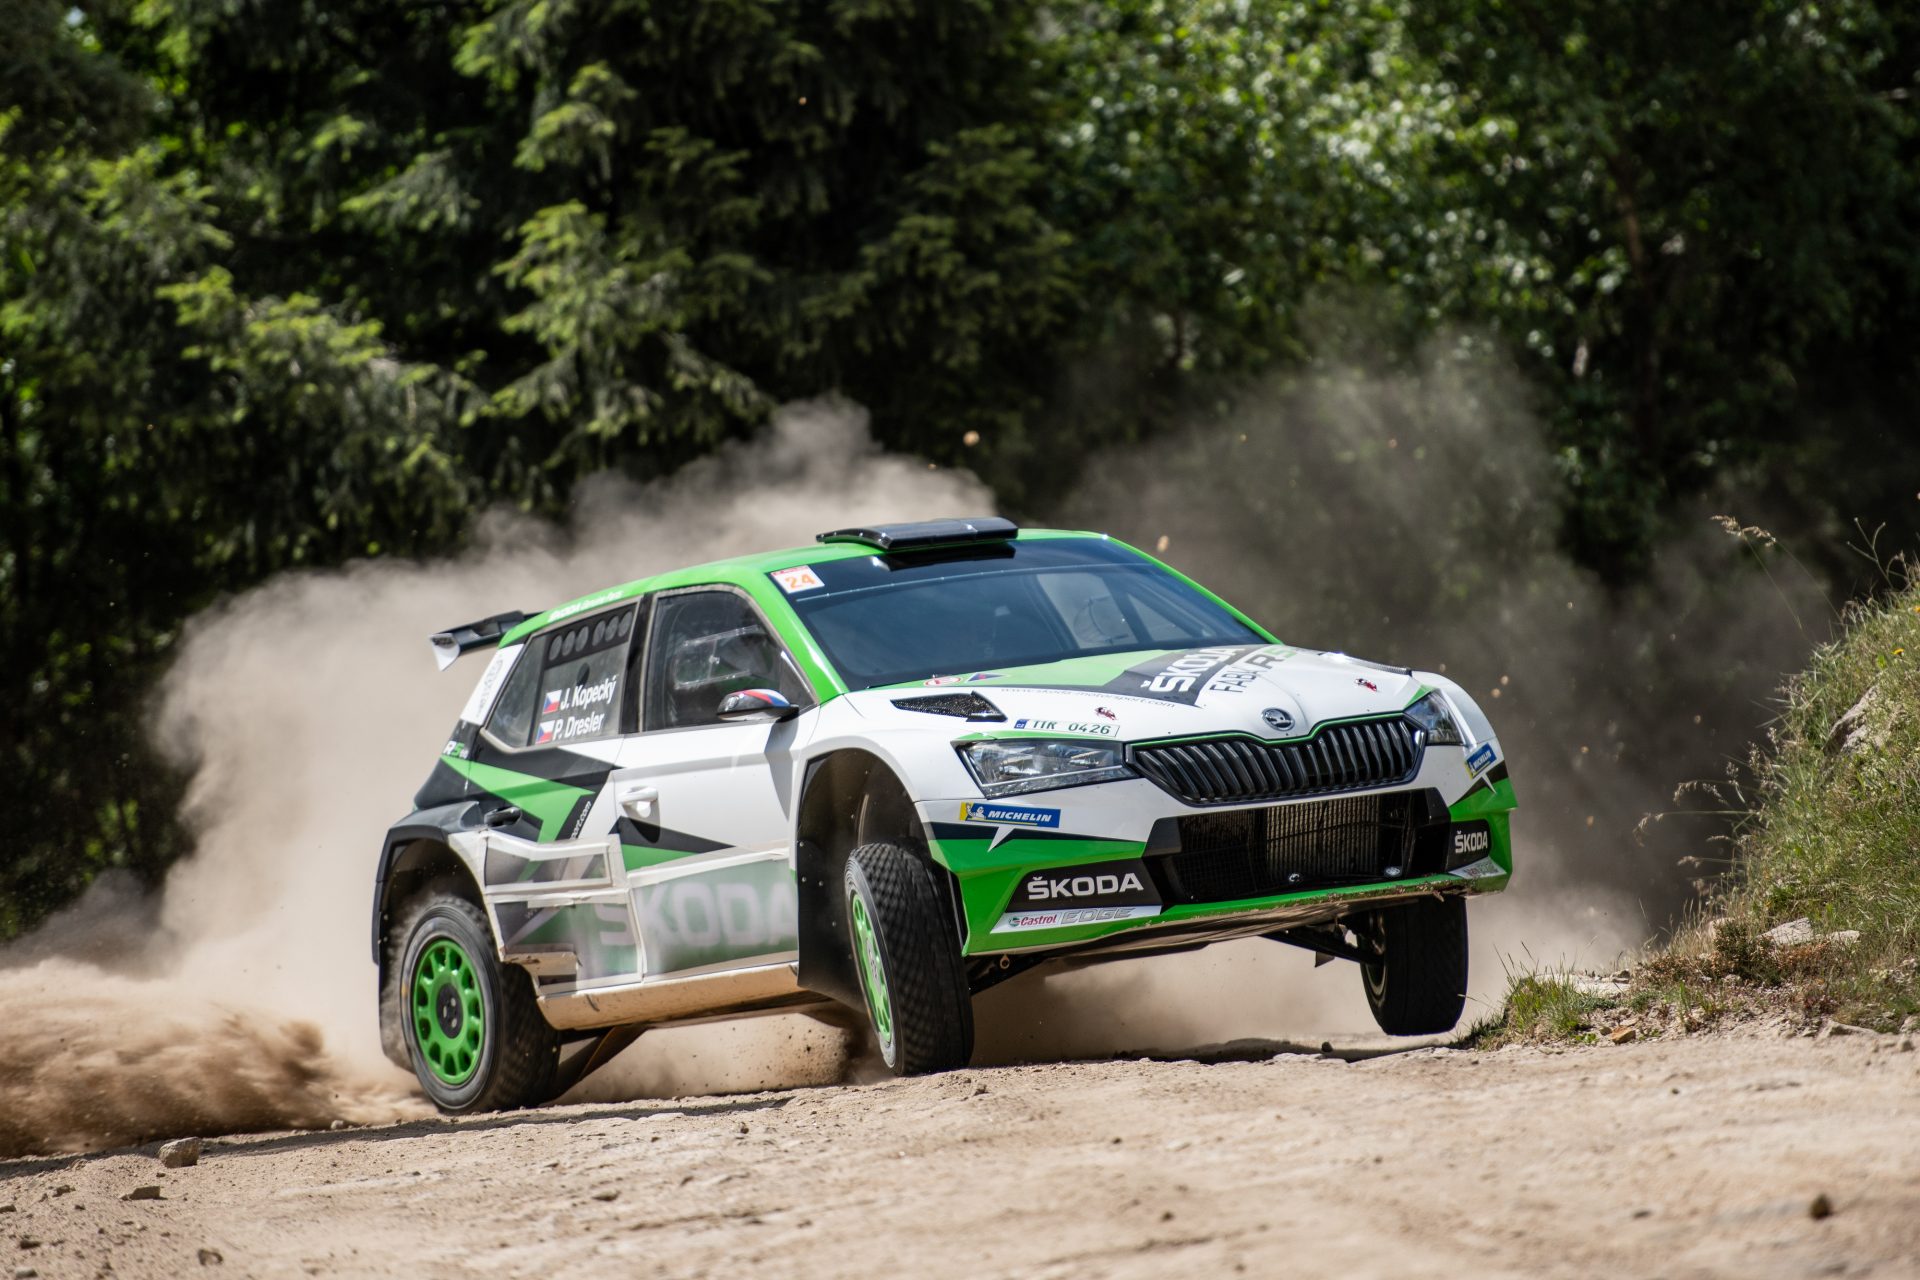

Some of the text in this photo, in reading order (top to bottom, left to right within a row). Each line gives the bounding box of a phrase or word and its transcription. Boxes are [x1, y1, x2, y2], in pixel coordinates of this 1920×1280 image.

[785, 574, 816, 589] 24
[1141, 648, 1246, 693] ŠKODA
[560, 674, 618, 711] J. Kopecký
[552, 711, 605, 741] P. Dresler
[1068, 722, 1111, 735] 0426
[987, 810, 1053, 823] MICHELIN
[1454, 830, 1488, 854] ŠKODA
[1027, 872, 1144, 901] ŠKODA
[1020, 907, 1136, 927] Castrol EDGE
